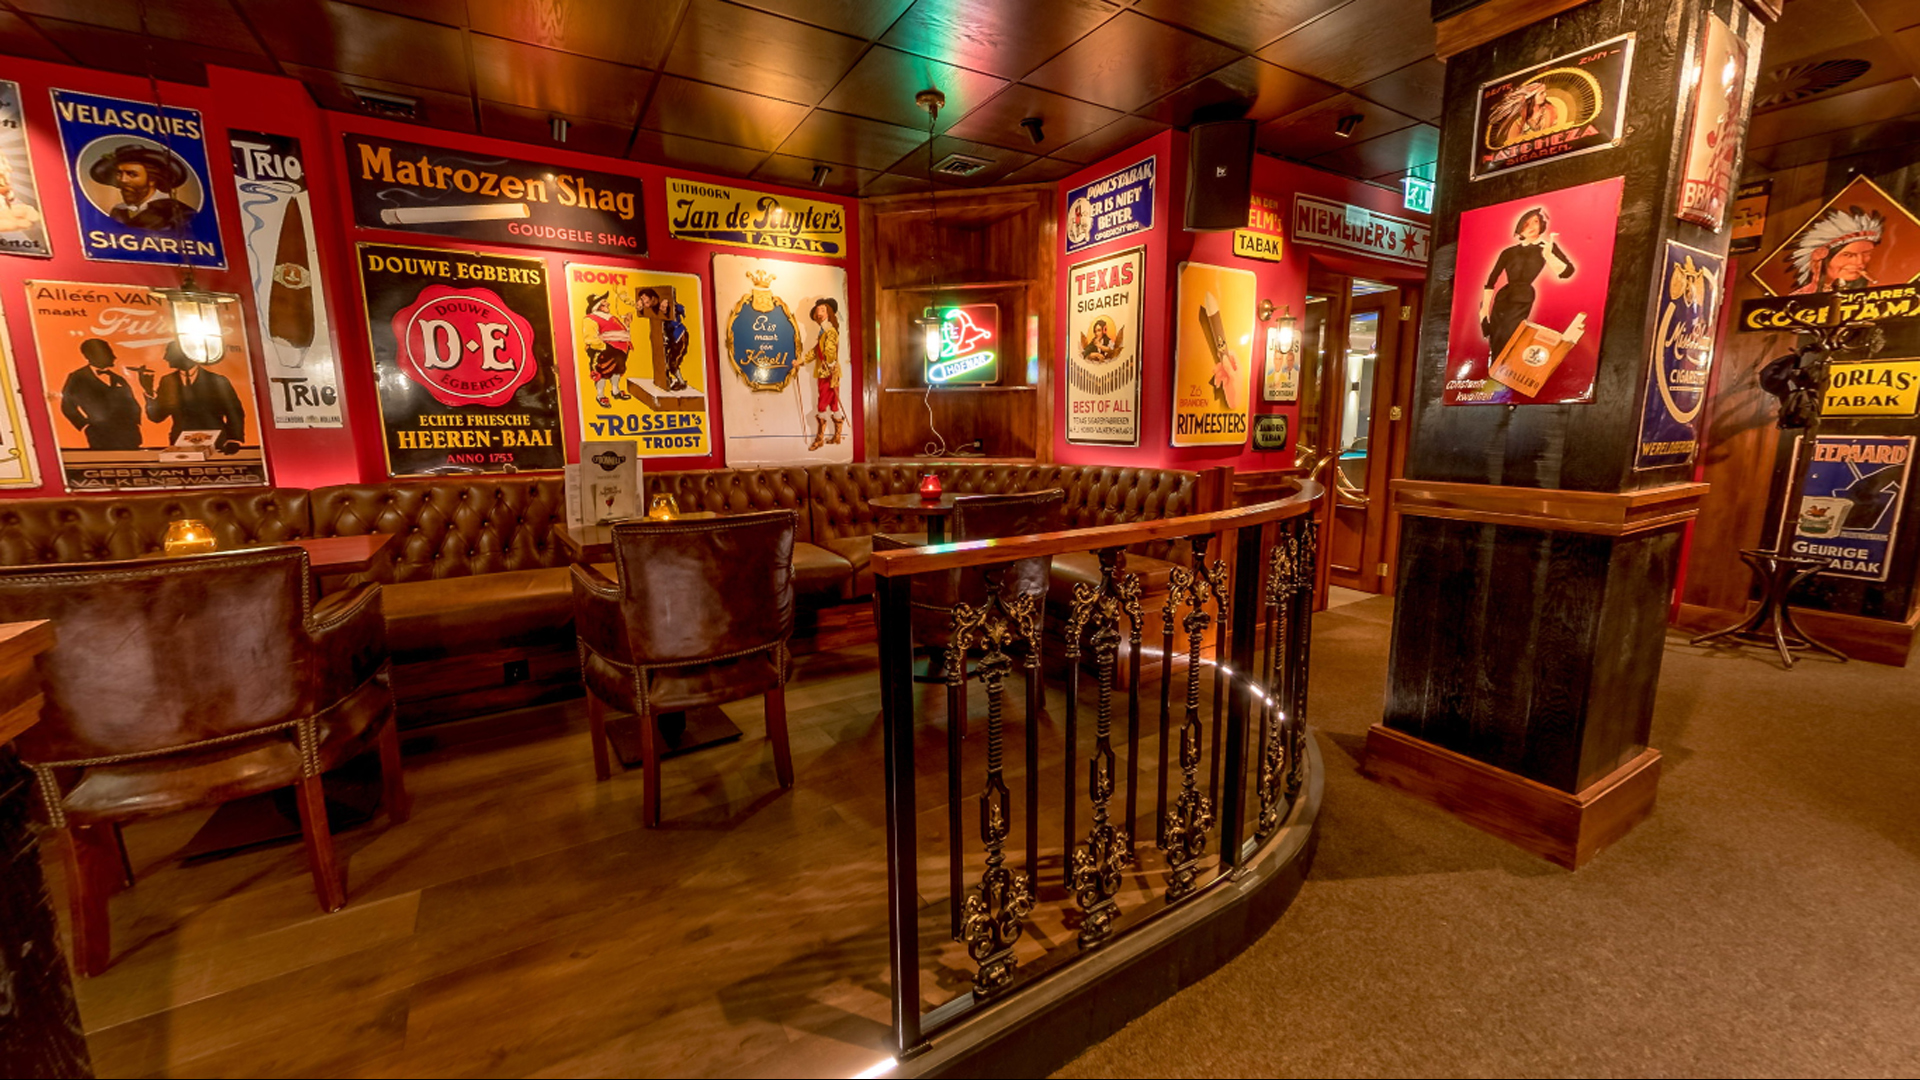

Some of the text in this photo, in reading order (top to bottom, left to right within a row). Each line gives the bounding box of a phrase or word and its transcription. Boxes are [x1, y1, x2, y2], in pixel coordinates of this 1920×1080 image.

[57, 101, 201, 140] VELASQUES
[230, 139, 302, 180] TRIO
[357, 143, 635, 220] Matrozen Shag
[672, 183, 731, 199] UITHOORN
[1115, 186, 1143, 209] NIET
[673, 198, 720, 229] Jan
[725, 202, 750, 229] de
[1097, 207, 1133, 230] BETER
[89, 230, 216, 257] SIGAREN
[507, 222, 638, 248] GOUDGELE SHAG
[742, 231, 825, 252] TABAK
[1238, 234, 1280, 255] TABAK
[367, 255, 541, 285] DOUWE EGBERTS
[573, 269, 629, 286] ROOKT
[1075, 262, 1133, 296] TEXAS
[38, 307, 87, 317] maakt
[434, 302, 490, 319] DOUWE
[1077, 292, 1129, 313] SIGAREN
[440, 373, 504, 391] EGBERTS
[1830, 368, 1909, 391] ORLAS
[270, 377, 337, 412] TRIO
[1826, 394, 1899, 407] TABAK
[1073, 399, 1132, 414] BEST OF ALL
[419, 414, 531, 427] ECHTE FRIESCHE
[1177, 413, 1246, 435] RITMEESTERS
[642, 436, 701, 448] TROOST
[446, 453, 514, 463] ANNO 1753
[1813, 443, 1908, 464] EEPAARD
[71, 474, 260, 487] VALKENSWAARD
[1792, 541, 1869, 560] GEURIGE
[1827, 558, 1880, 573] ABAK
